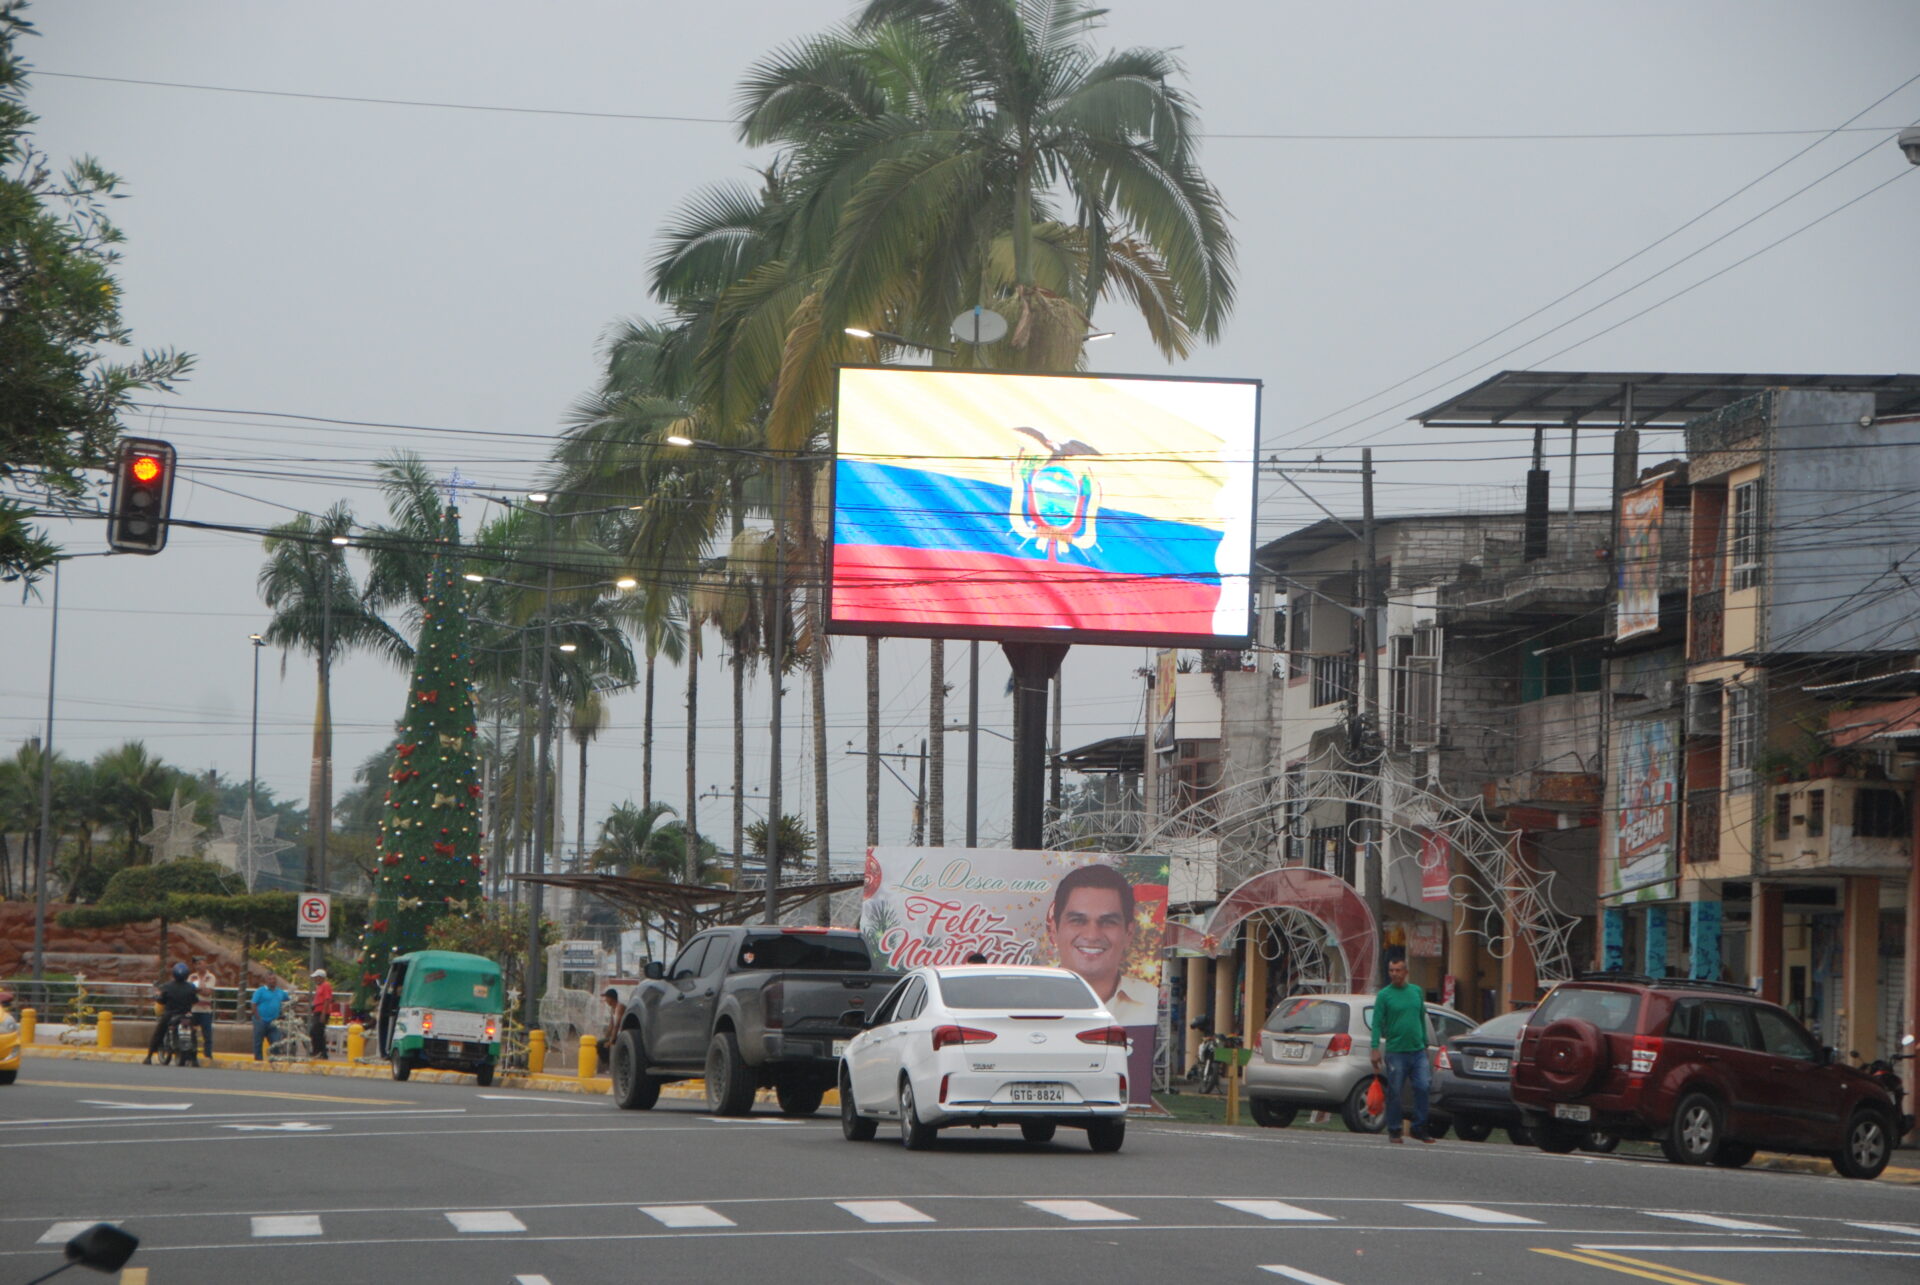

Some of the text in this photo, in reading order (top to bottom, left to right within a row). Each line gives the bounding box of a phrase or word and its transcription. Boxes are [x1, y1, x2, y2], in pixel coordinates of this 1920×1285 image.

[892, 857, 1050, 894] Les Desea una
[905, 895, 1014, 937] Feliz
[1013, 1089, 1062, 1101] GTG-8824
